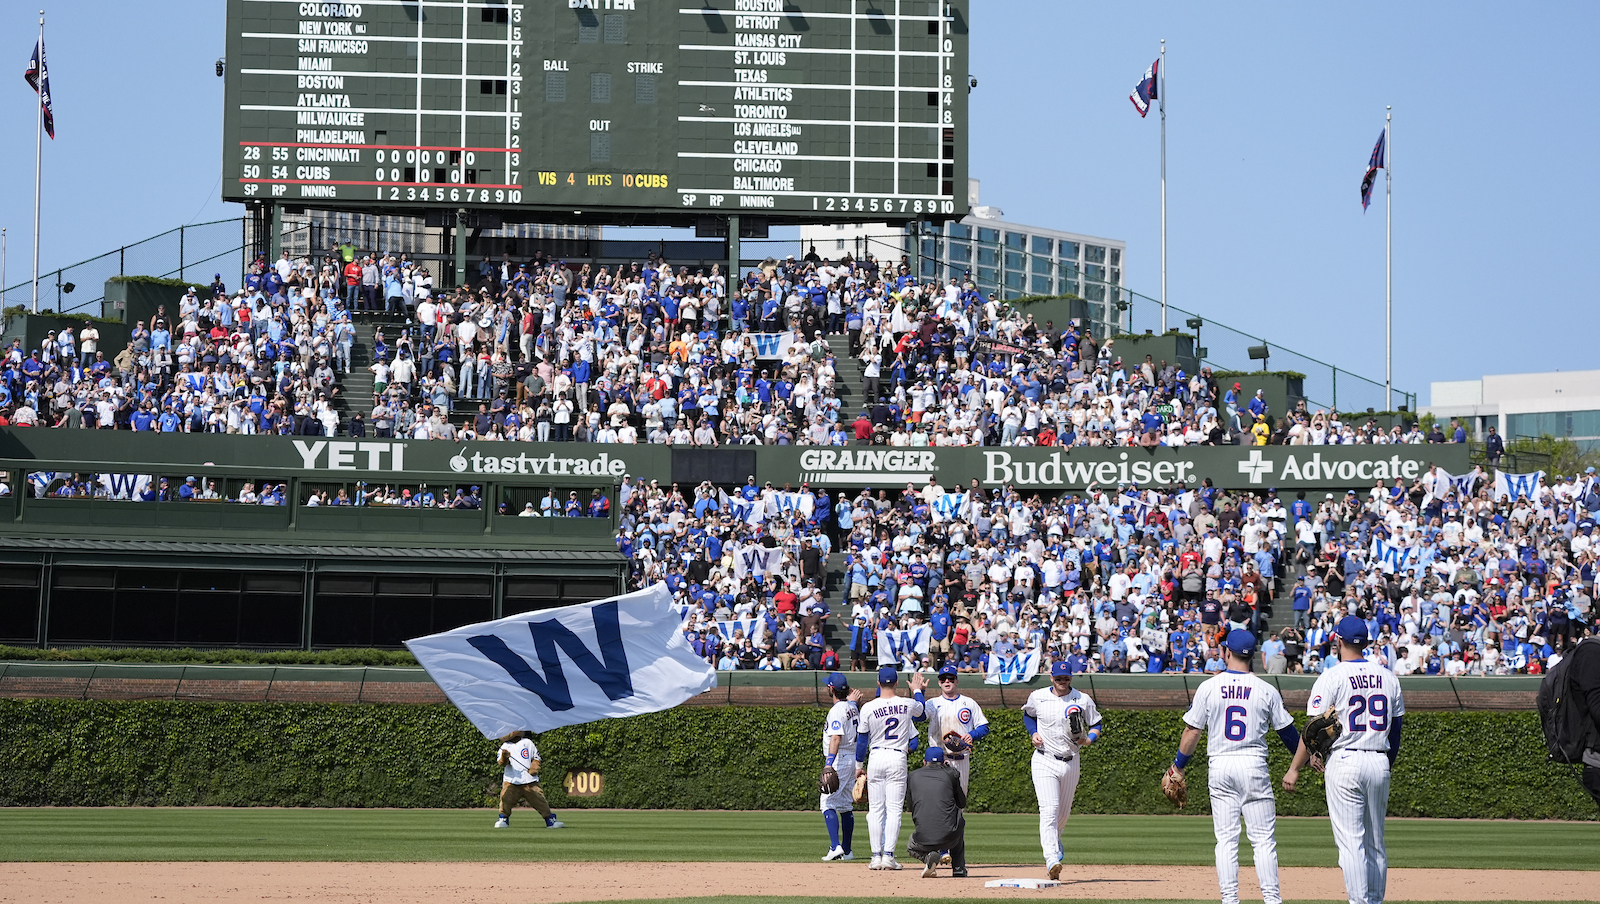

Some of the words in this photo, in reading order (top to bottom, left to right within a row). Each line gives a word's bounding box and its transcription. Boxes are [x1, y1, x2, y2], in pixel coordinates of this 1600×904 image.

[299, 3, 362, 18] COLORADO
[735, 0, 784, 12] HOUSTON
[513, 9, 521, 22] 3
[299, 21, 320, 34] NEW
[324, 22, 352, 35] YORK
[355, 24, 366, 34] (NL)
[735, 16, 780, 30] DETROIT
[513, 27, 521, 40] 5
[298, 40, 316, 53] SAN
[318, 40, 368, 54] FRANCISCO
[735, 33, 777, 48] KANSAS
[778, 34, 802, 49] CITY
[943, 40, 952, 53] 0
[512, 45, 521, 58] 4
[299, 57, 332, 71] MIAMI
[543, 60, 569, 72] BALL
[734, 52, 751, 65] ST.
[754, 52, 786, 66] LOUIS
[512, 63, 521, 76] 2
[627, 62, 663, 74] STRIKE
[298, 76, 343, 90] BOSTON
[734, 69, 768, 83] TEXAS
[943, 75, 952, 88] 8
[512, 81, 521, 95] 3
[734, 87, 793, 102] ATHLETICS
[297, 94, 351, 108] ATLANTA
[943, 93, 952, 106] 4
[297, 112, 365, 126] MILWAUKEE
[734, 105, 787, 120] TORONTO
[943, 111, 952, 124] 8
[512, 118, 520, 131] 5
[590, 120, 611, 131] OUT
[734, 123, 751, 136] LOS
[297, 130, 366, 145] PHILADELPHIA
[512, 135, 520, 148] 2
[734, 141, 798, 155] CLEVELAND
[244, 147, 261, 161] 28
[272, 147, 289, 161] 55
[297, 148, 360, 163] CINCINNATI
[375, 150, 385, 163] 0
[391, 150, 400, 163] 0
[406, 151, 415, 164] 0
[421, 151, 430, 164] 0
[436, 151, 445, 165] 0
[466, 152, 475, 165] 0
[511, 153, 520, 166] 3
[734, 159, 782, 173] CHICAGO
[243, 165, 260, 179] 50
[271, 166, 288, 180] 54
[296, 166, 330, 180] CUBS
[375, 168, 385, 181] 0
[390, 168, 400, 182] 0
[421, 169, 430, 182] 0
[450, 170, 460, 183] 0
[511, 171, 519, 185] 7
[538, 172, 557, 185] VIS
[567, 173, 575, 185] 4
[587, 174, 612, 186] HITS
[635, 174, 668, 188] CUBS
[734, 177, 795, 191] BALTIMORE
[244, 184, 258, 196] SP
[271, 185, 286, 197] RP
[301, 185, 336, 198] INNING
[390, 187, 399, 200] 2
[407, 187, 416, 201] 3
[420, 188, 429, 201] 4
[435, 188, 444, 201] 5
[450, 189, 459, 202] 6
[466, 189, 475, 202] 7
[480, 189, 489, 203] 8
[495, 190, 504, 203] 9
[508, 190, 521, 203] 10
[682, 195, 697, 206] SP
[709, 195, 724, 207] RP
[740, 196, 774, 208] INNING
[825, 198, 835, 211] 2
[840, 198, 850, 211] 3
[854, 198, 864, 211] 4
[870, 199, 879, 212] 5
[883, 199, 893, 212] 6
[899, 200, 908, 213] 7
[913, 200, 923, 213] 8
[927, 200, 937, 213] 9
[941, 201, 954, 214] 10
[755, 334, 781, 356] W
[292, 440, 404, 471] YETI
[800, 449, 935, 471] GRAINGER
[471, 451, 626, 476] tastytrade
[983, 451, 1194, 485] Budweiser
[1280, 452, 1418, 480] Advocate
[110, 474, 137, 498] W
[1505, 472, 1539, 500] W
[742, 549, 770, 571] W
[885, 627, 923, 662] W
[466, 600, 635, 712] W
[1348, 675, 1382, 690] BUSCH
[1221, 686, 1252, 700] SHAW
[873, 705, 908, 719] HOERNER
[1349, 694, 1388, 732] 29
[885, 717, 899, 740] 2
[1225, 705, 1247, 741] 6
[563, 771, 600, 793] 400
